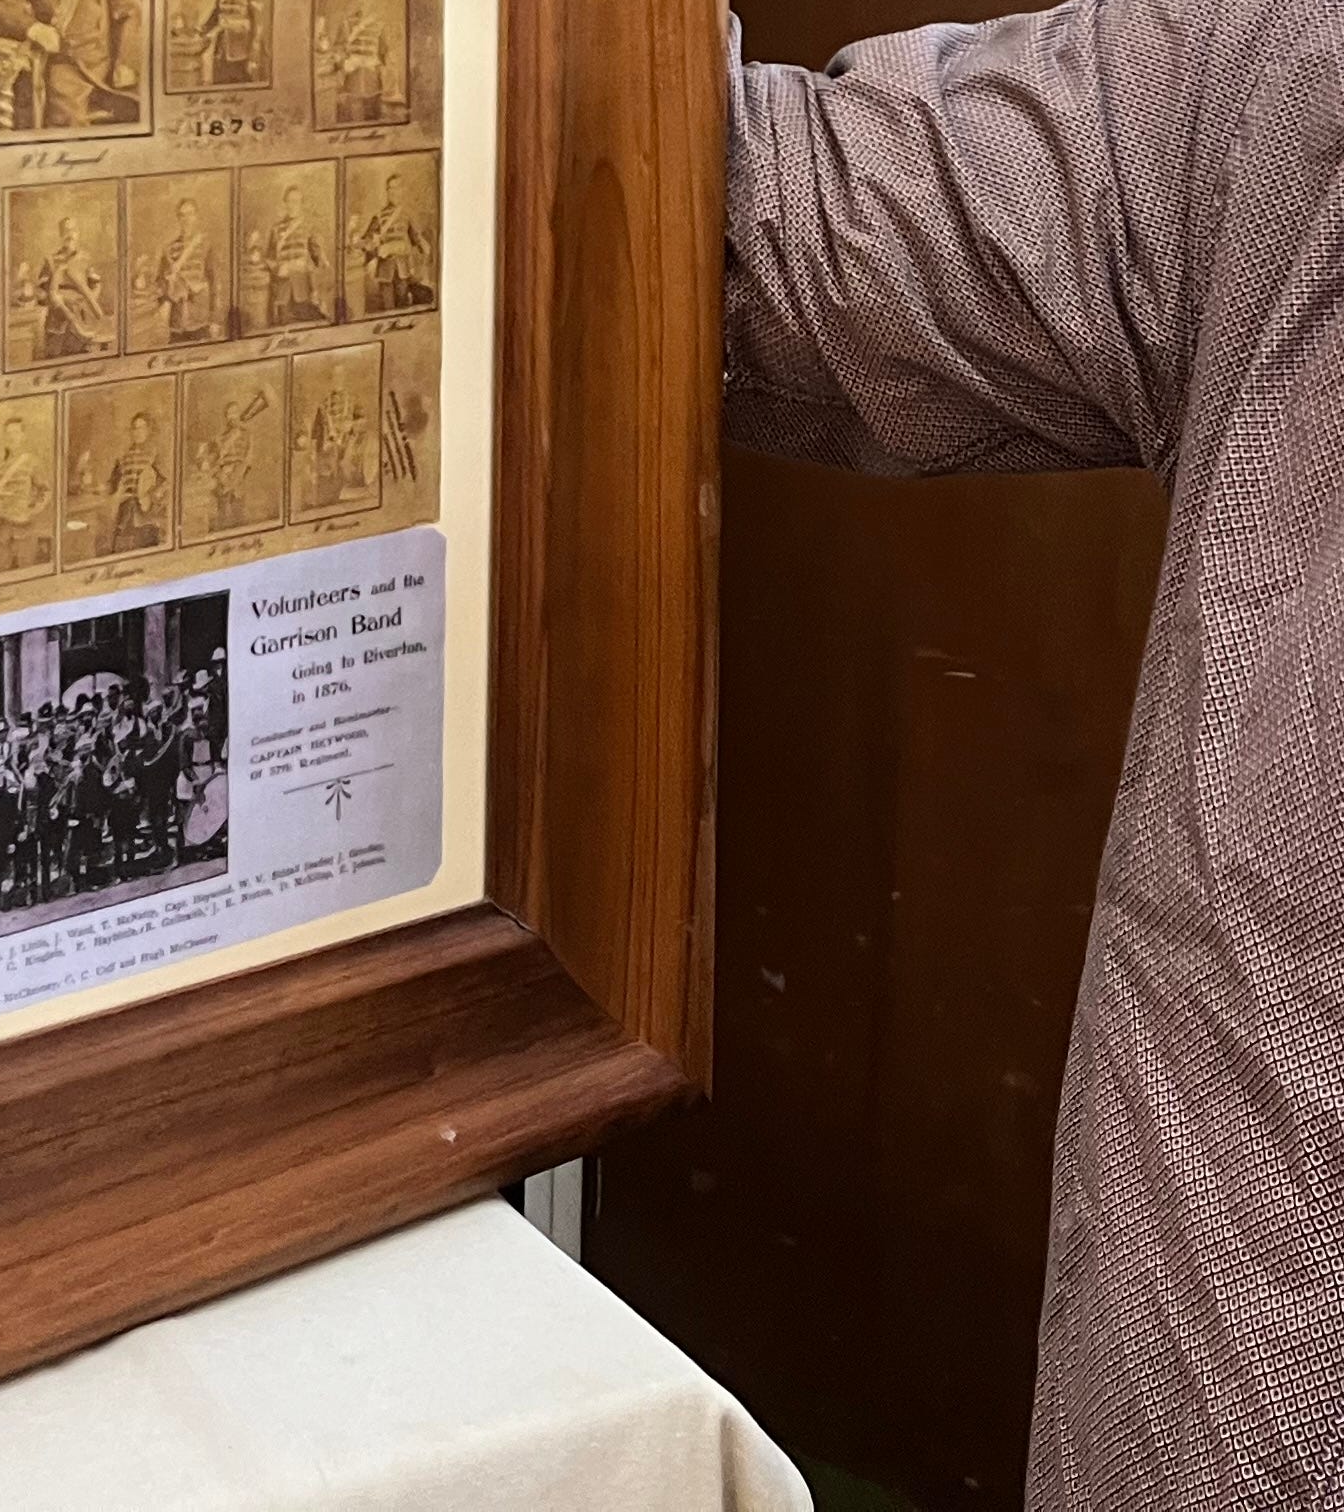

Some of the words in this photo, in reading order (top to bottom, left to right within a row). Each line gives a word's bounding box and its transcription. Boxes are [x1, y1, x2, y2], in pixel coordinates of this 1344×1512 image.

[195, 117, 266, 138] 1876
[251, 584, 361, 620] Volunteers
[370, 578, 396, 596] and
[403, 574, 425, 589] the
[250, 624, 338, 657] Garrison
[351, 606, 402, 636] Band
[292, 659, 333, 681] Going
[341, 655, 355, 670] to
[292, 689, 305, 705] in
[250, 744, 302, 765] CAPTAIN
